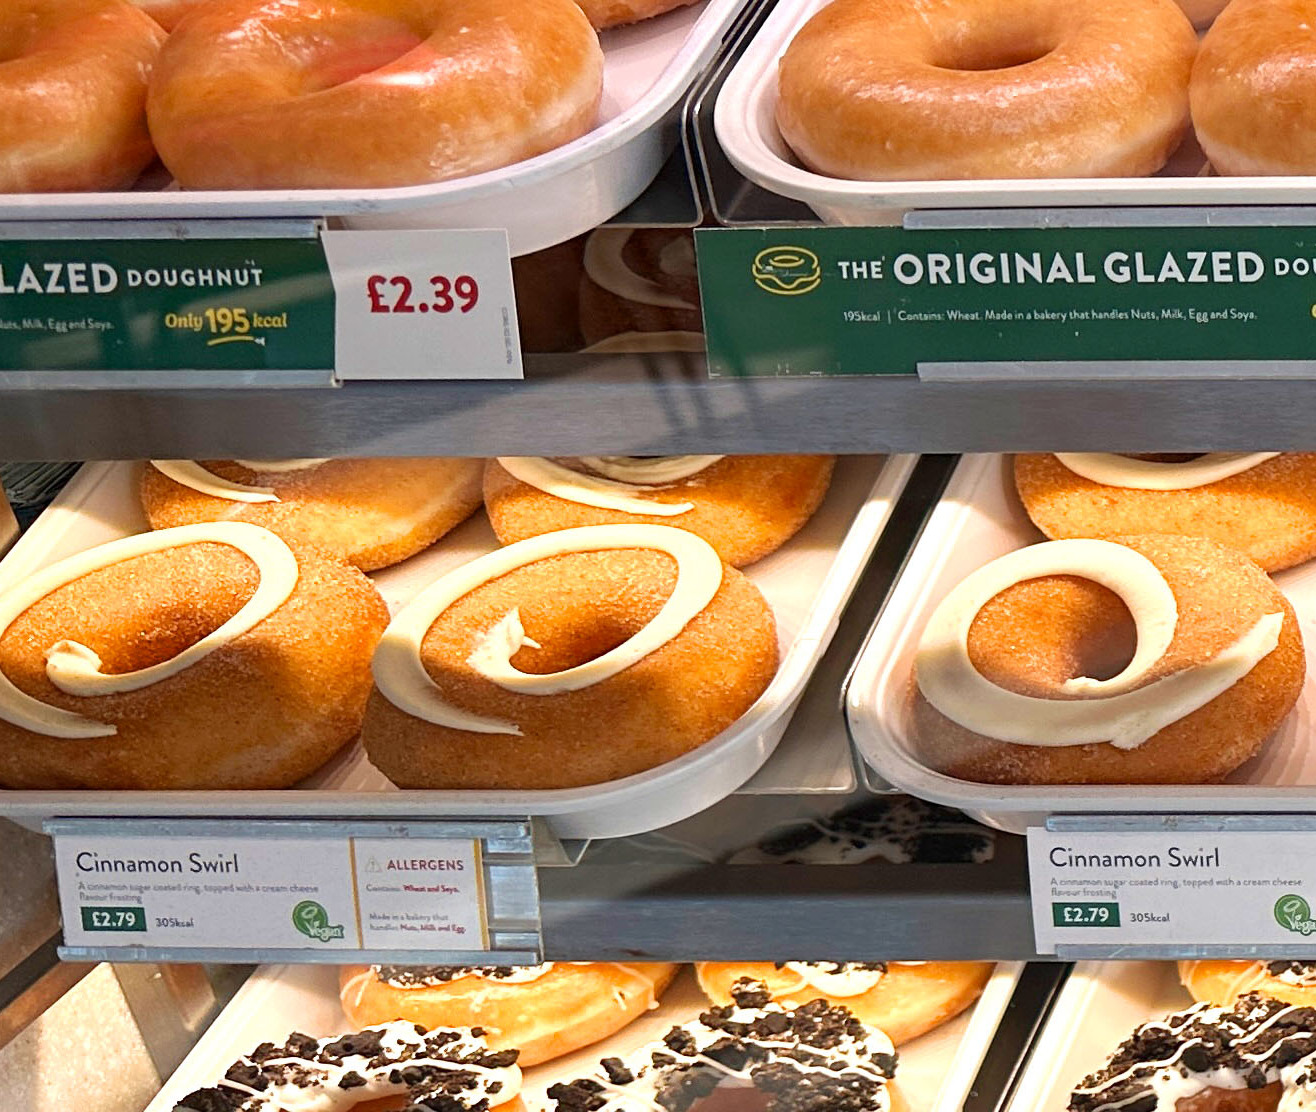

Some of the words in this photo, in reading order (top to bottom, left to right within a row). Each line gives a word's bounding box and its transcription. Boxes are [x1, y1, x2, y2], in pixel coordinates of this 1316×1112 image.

[838, 261, 883, 280] THE
[893, 252, 1096, 285] ORIGINAL
[1103, 251, 1265, 284] GLAZED
[0, 263, 118, 294] LAZED
[127, 269, 262, 287] DOUGHNUT
[367, 275, 479, 313] £2.39
[165, 313, 203, 333] Only
[205, 308, 250, 334] 195
[253, 311, 288, 328] kcal
[843, 310, 881, 322] 195kcal
[897, 310, 945, 321] Contains:
[985, 310, 1013, 321] Made
[1014, 310, 1024, 320] in
[1033, 310, 1067, 323] bakery
[1069, 310, 1089, 320] that
[1091, 310, 1128, 320] handles
[1131, 309, 1159, 321] Nuts,
[1161, 309, 1187, 321] Milk,
[1189, 309, 1209, 322] Egg
[1210, 309, 1228, 320] and
[1230, 309, 1258, 321] Soya.
[0, 319, 21, 331] uts,
[76, 851, 183, 873] Cinnamon
[189, 852, 240, 873] Swirl
[387, 859, 464, 871] ALLERGENS
[1049, 847, 1161, 868] Cinnamon
[1168, 847, 1220, 868] Swirl
[92, 911, 136, 927] £2.79
[155, 917, 195, 928] 305kcal
[1063, 907, 1110, 923] £2.79
[1130, 912, 1170, 923] 305kcal
